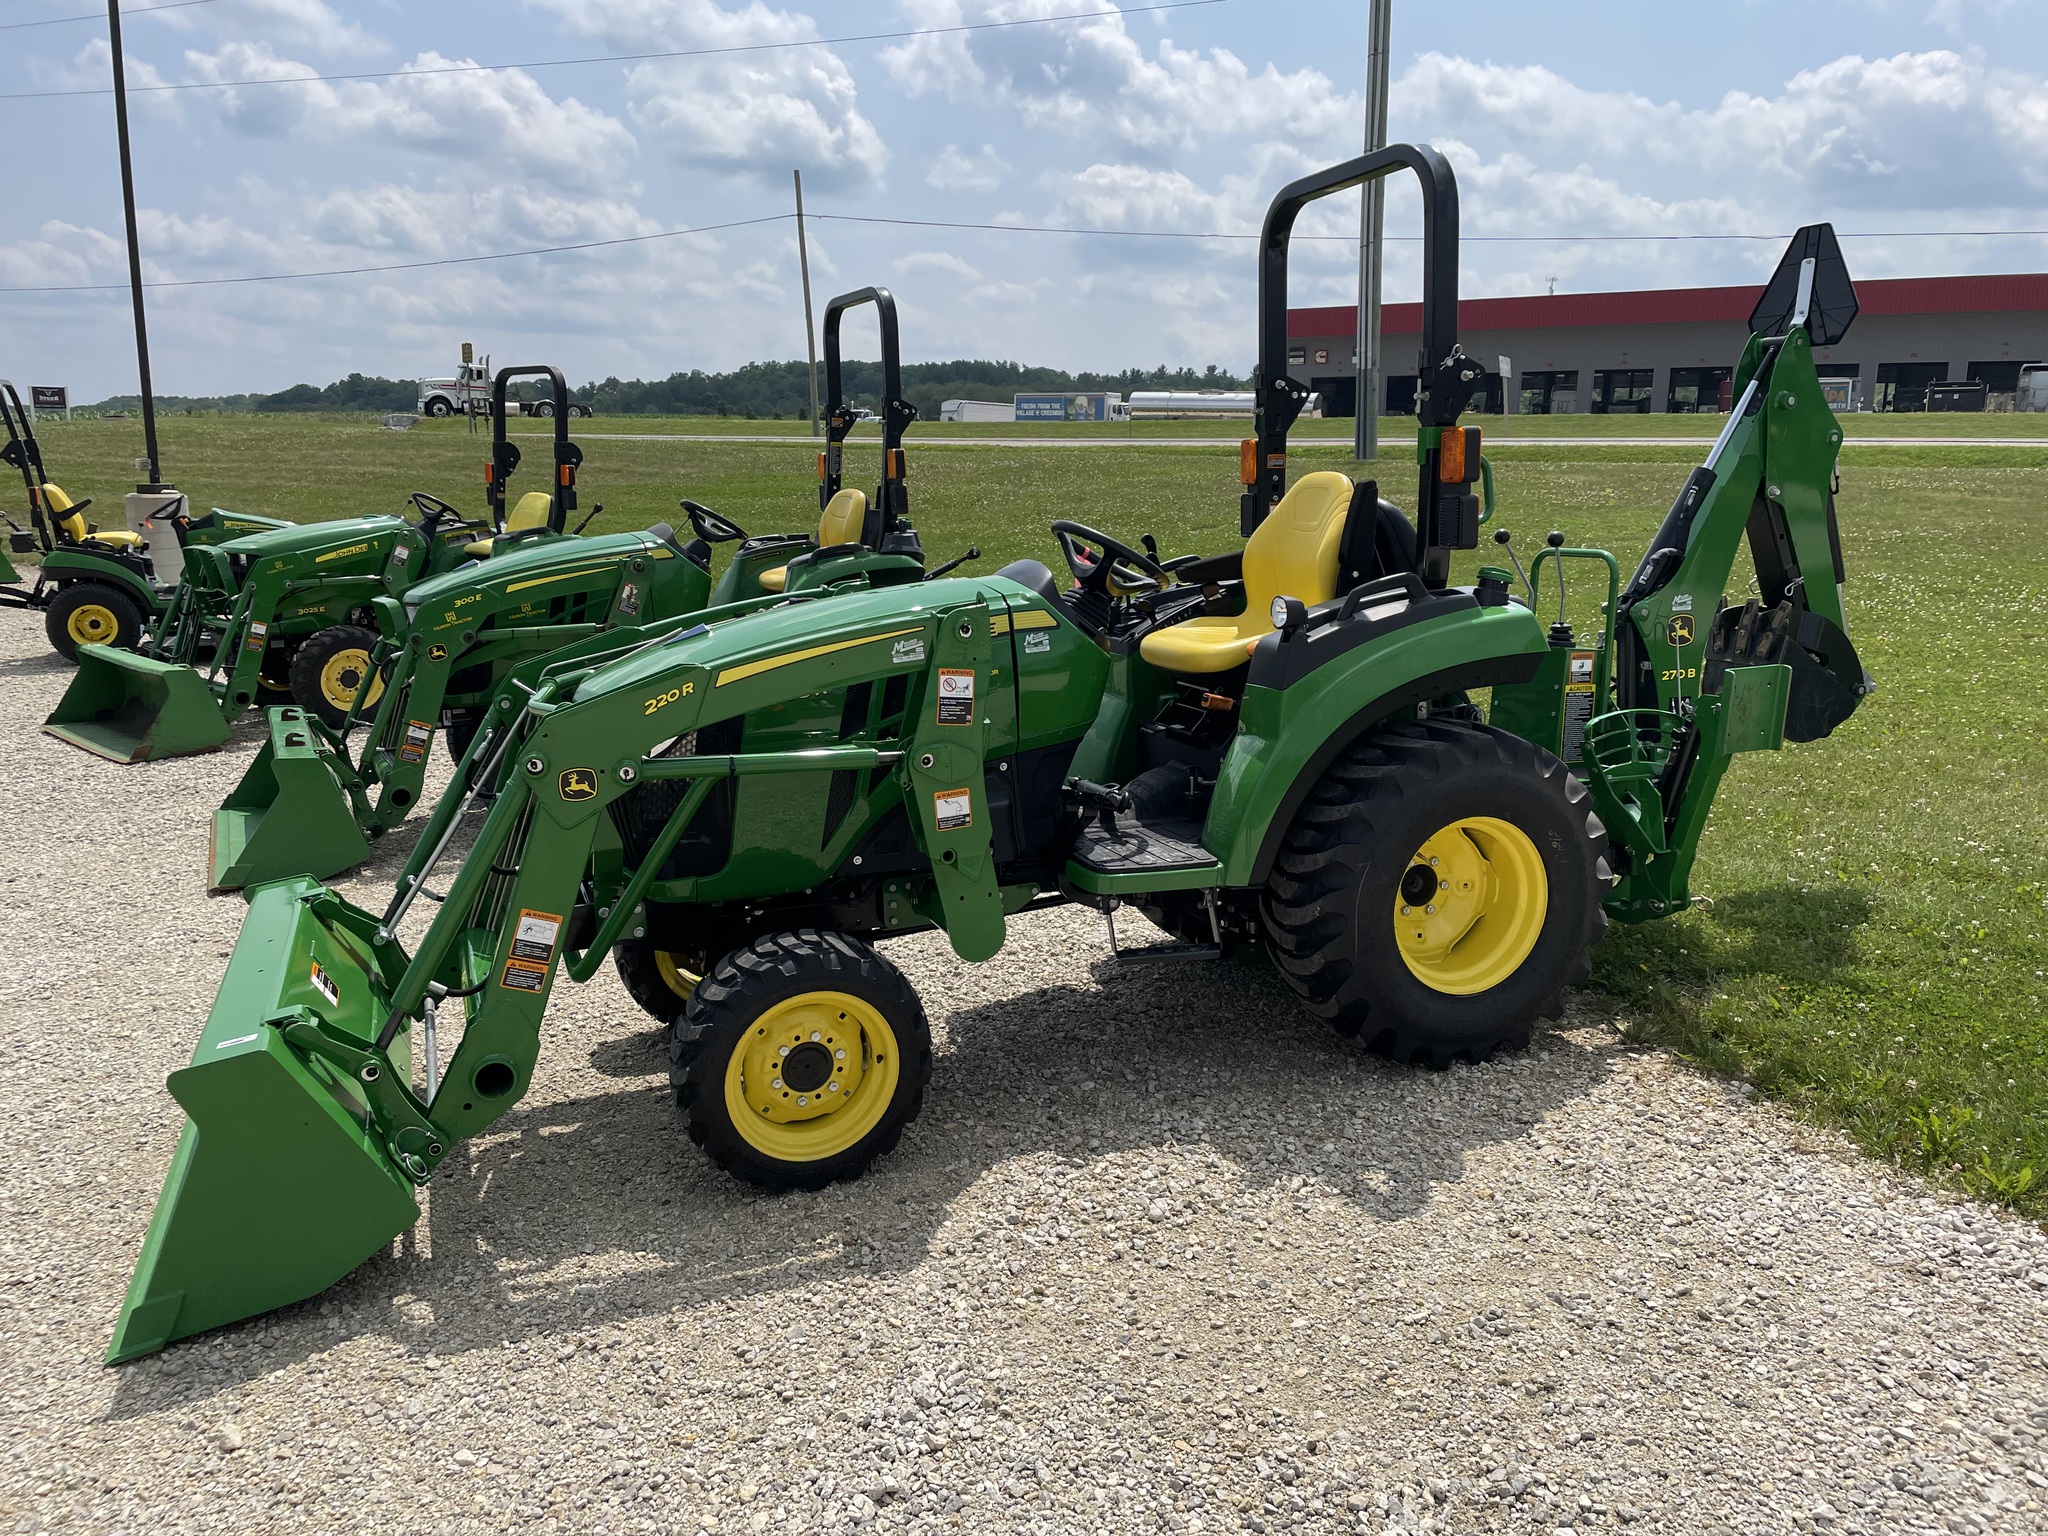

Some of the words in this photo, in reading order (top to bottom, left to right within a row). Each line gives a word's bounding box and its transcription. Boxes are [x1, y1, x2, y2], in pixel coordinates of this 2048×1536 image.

[334, 547, 354, 559] JOHN
[454, 597, 475, 608] 300
[475, 593, 482, 601] E
[297, 607, 318, 616] 3025
[450, 616, 473, 626] TRACTOR
[1661, 669, 1686, 681] 270
[1687, 668, 1696, 678] B
[644, 688, 680, 716] 220
[682, 681, 694, 697] R
[941, 789, 968, 798] WARNING
[532, 912, 558, 921] WARNING
[518, 963, 544, 972] WARNING
